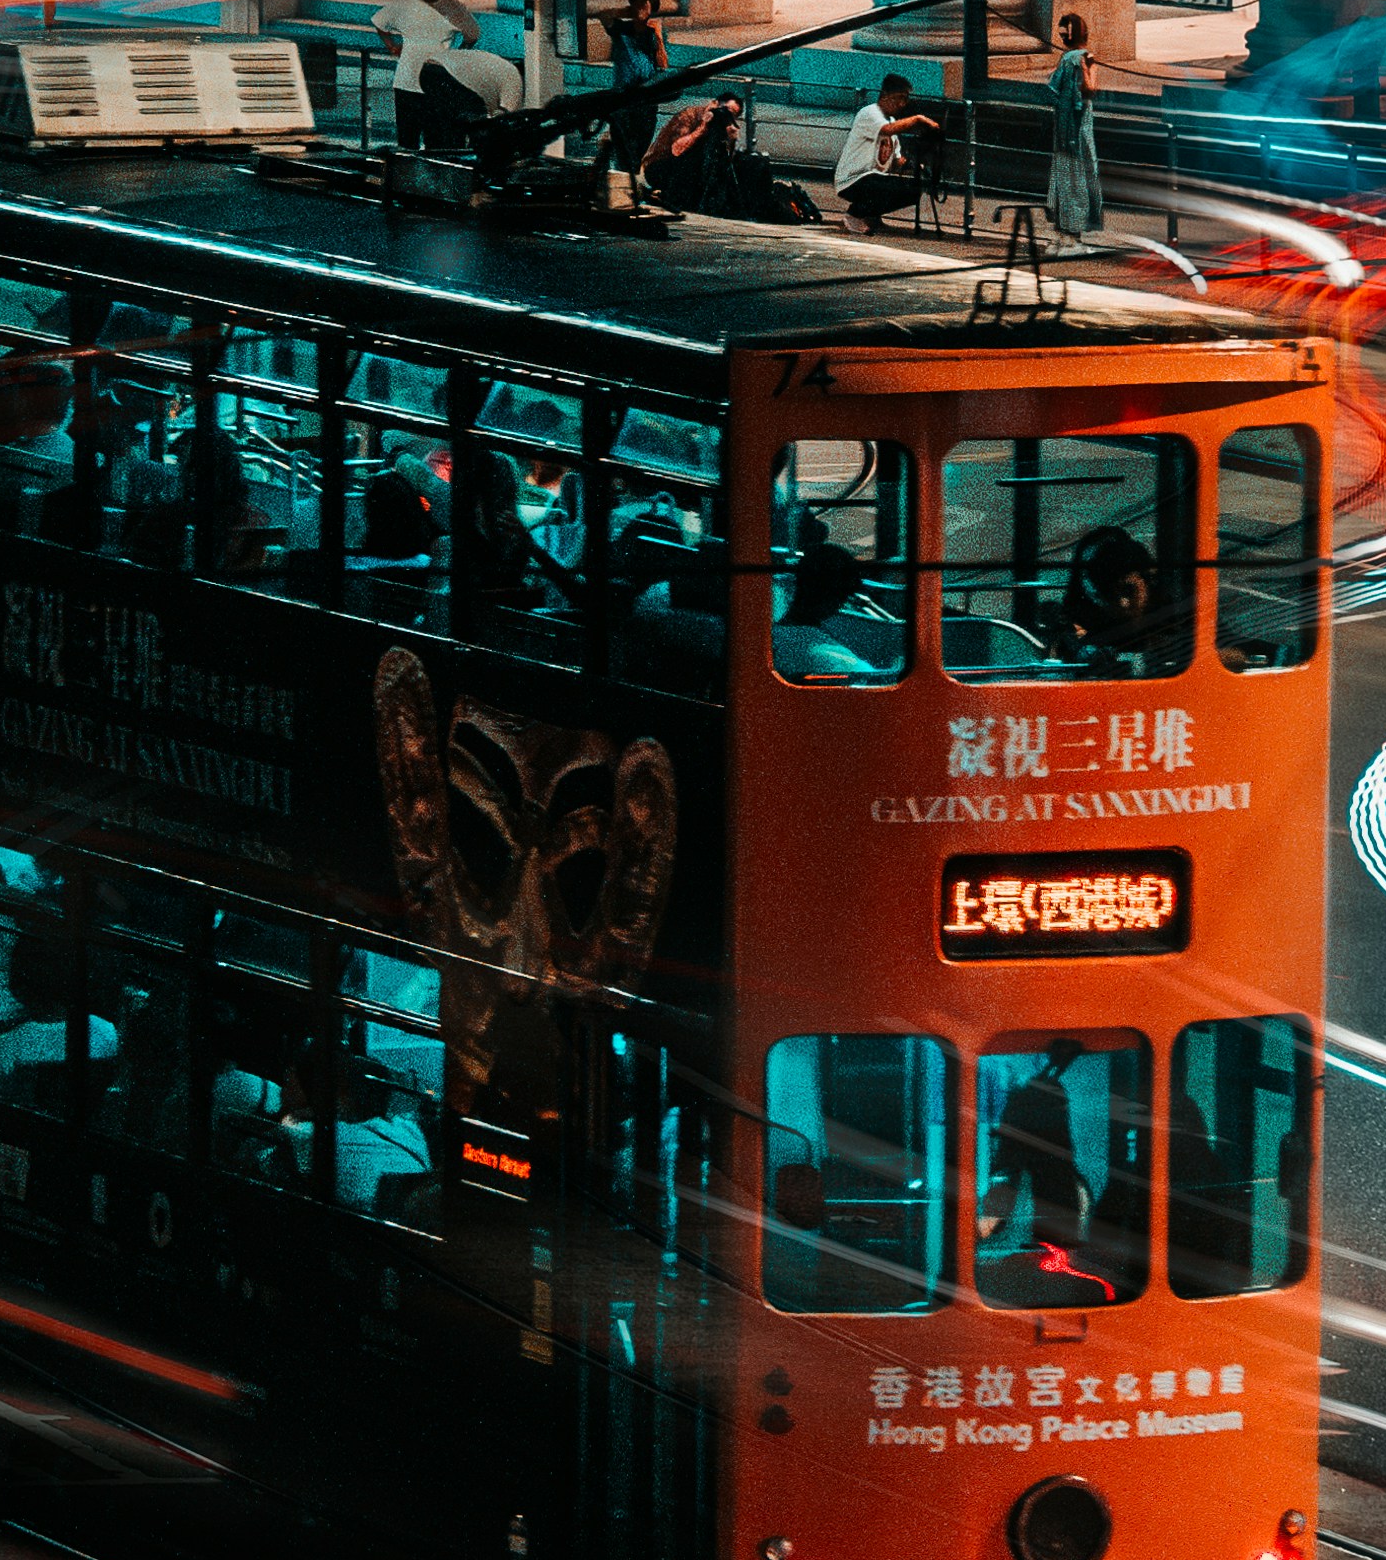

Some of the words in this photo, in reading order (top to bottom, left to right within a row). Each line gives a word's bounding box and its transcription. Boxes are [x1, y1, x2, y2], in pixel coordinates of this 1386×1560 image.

[771, 353, 837, 398] 74
[870, 795, 1008, 823] GAZING
[1015, 793, 1061, 822] AT
[1064, 781, 1252, 821] SANXINGDUI
[867, 1418, 947, 1453] Hong
[955, 1417, 1033, 1452] Kong
[1039, 1414, 1130, 1443] Palace
[1136, 1410, 1244, 1438] Museum
